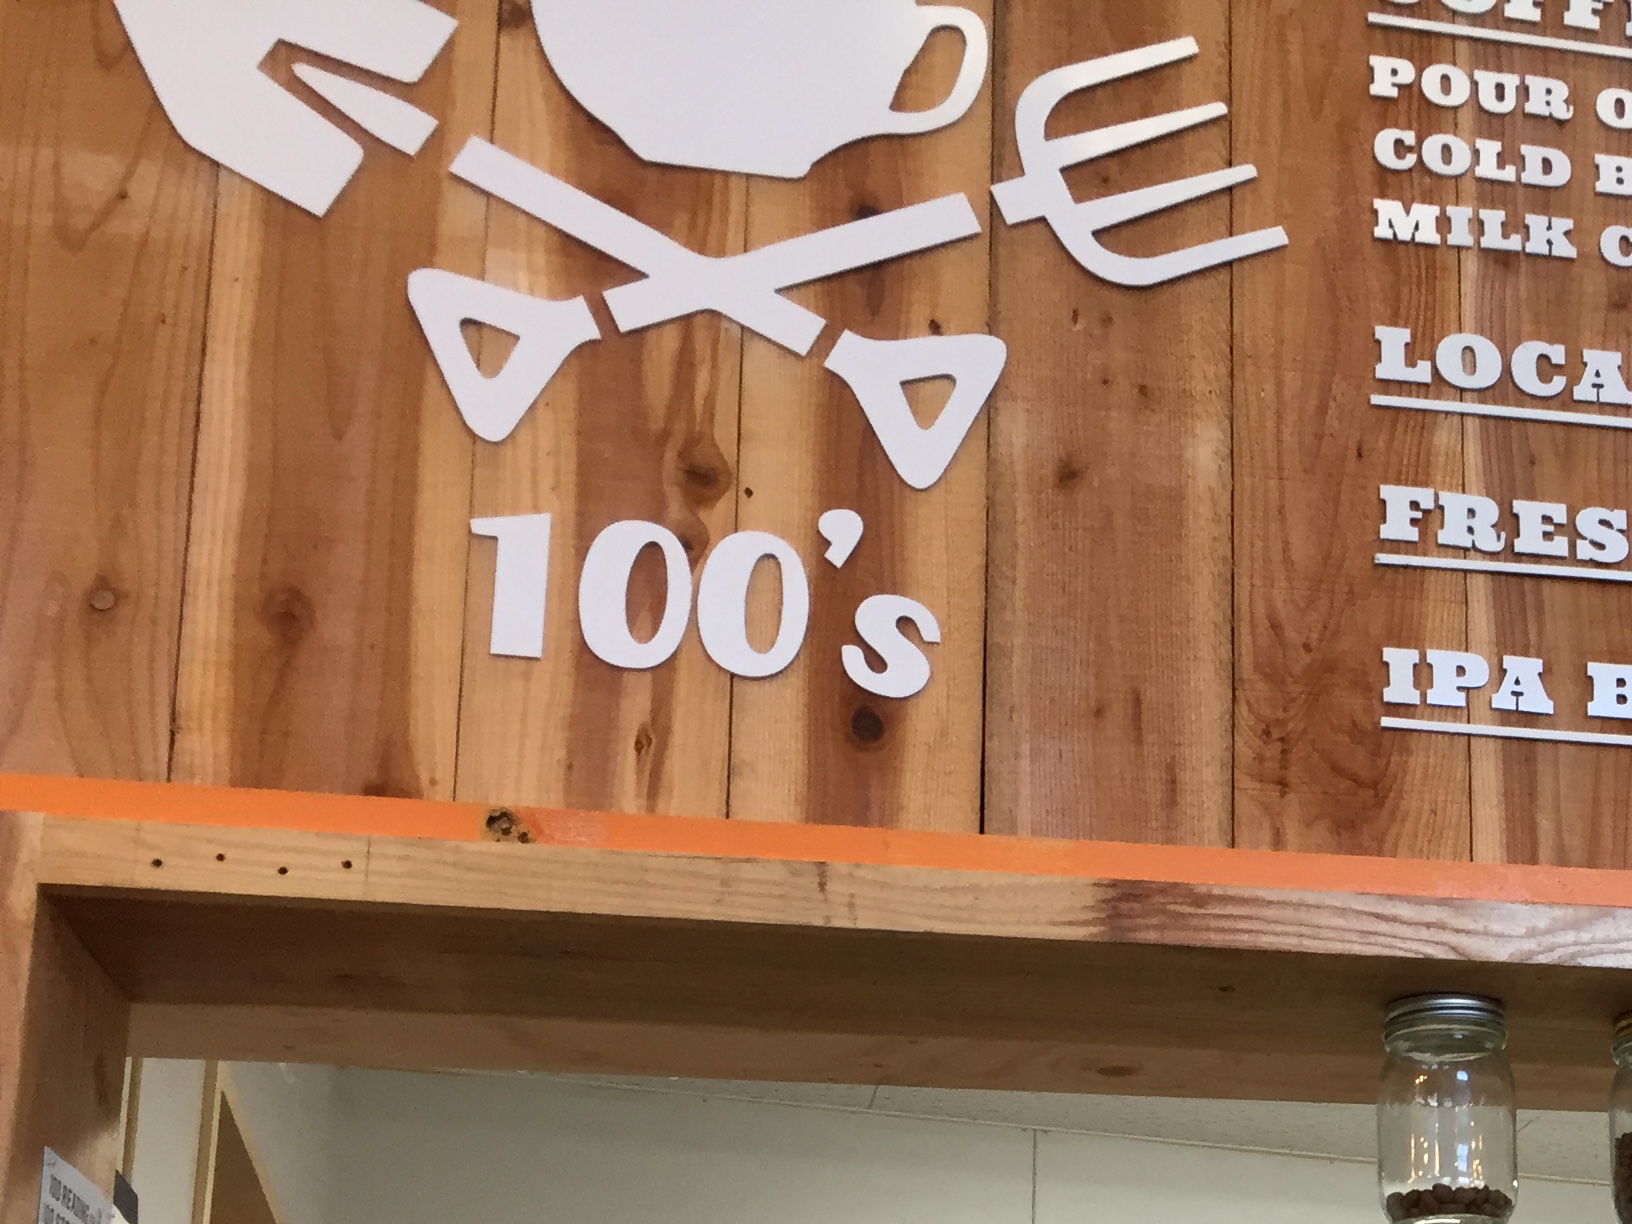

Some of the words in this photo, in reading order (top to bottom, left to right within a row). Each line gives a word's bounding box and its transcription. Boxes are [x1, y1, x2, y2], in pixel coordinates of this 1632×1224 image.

[1368, 55, 1573, 120] POUR
[1373, 128, 1573, 189] COLD
[1373, 199, 1577, 259] MILK
[470, 508, 941, 698] 100's
[1382, 647, 1554, 715] IPA
